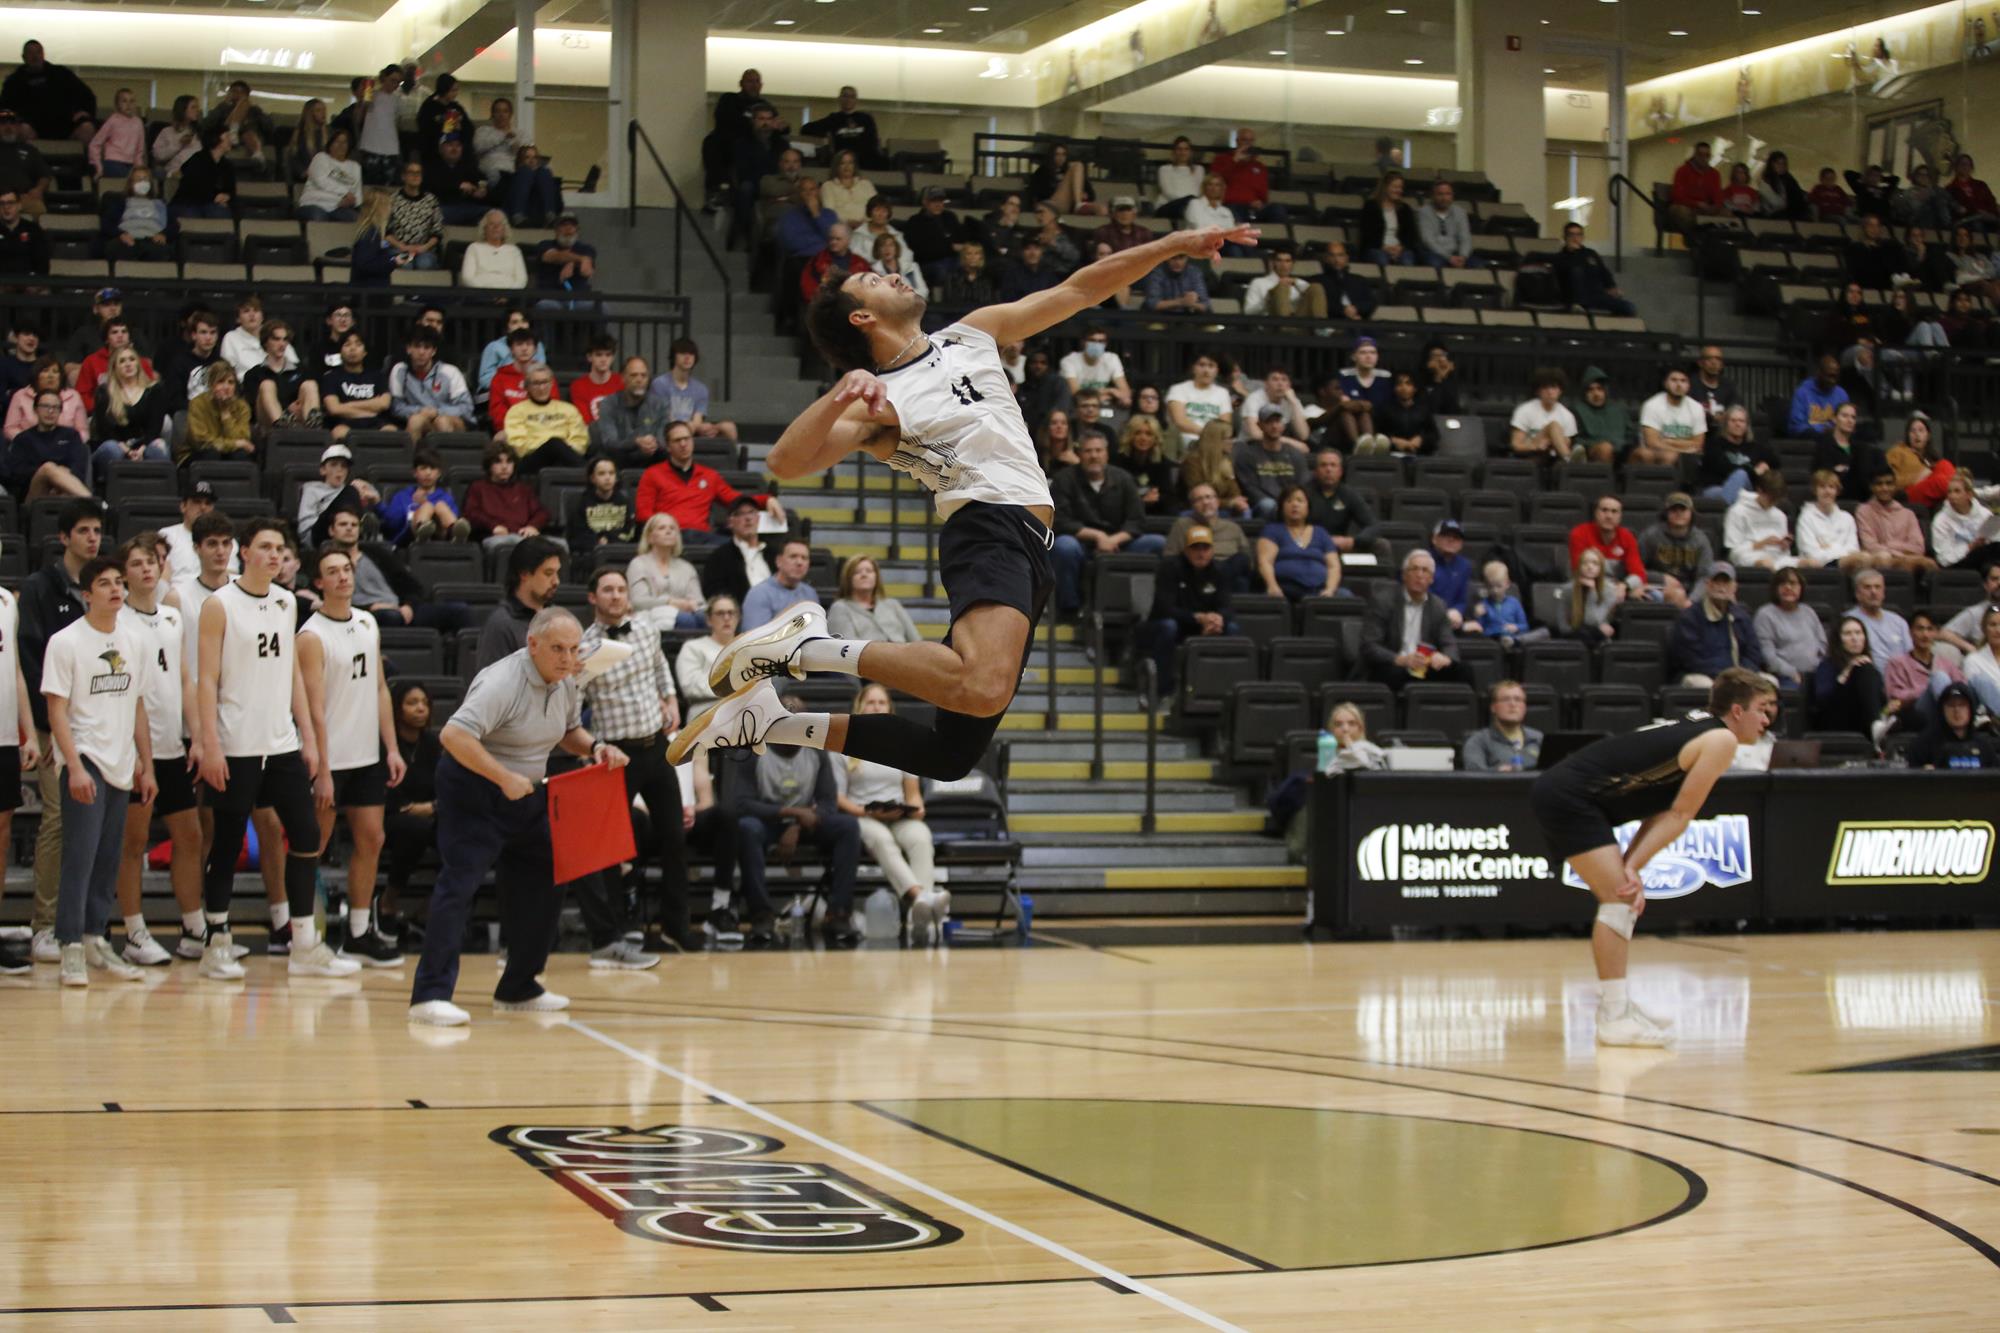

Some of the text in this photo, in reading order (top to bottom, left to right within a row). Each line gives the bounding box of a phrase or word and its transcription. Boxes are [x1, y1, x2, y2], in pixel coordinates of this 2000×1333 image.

[258, 632, 280, 657] 24
[158, 651, 168, 672] 4
[1402, 823, 1510, 850] Midwest
[1835, 828, 1989, 877] LINDENWOOD
[1402, 885, 1499, 898] RISING TOGETHER
